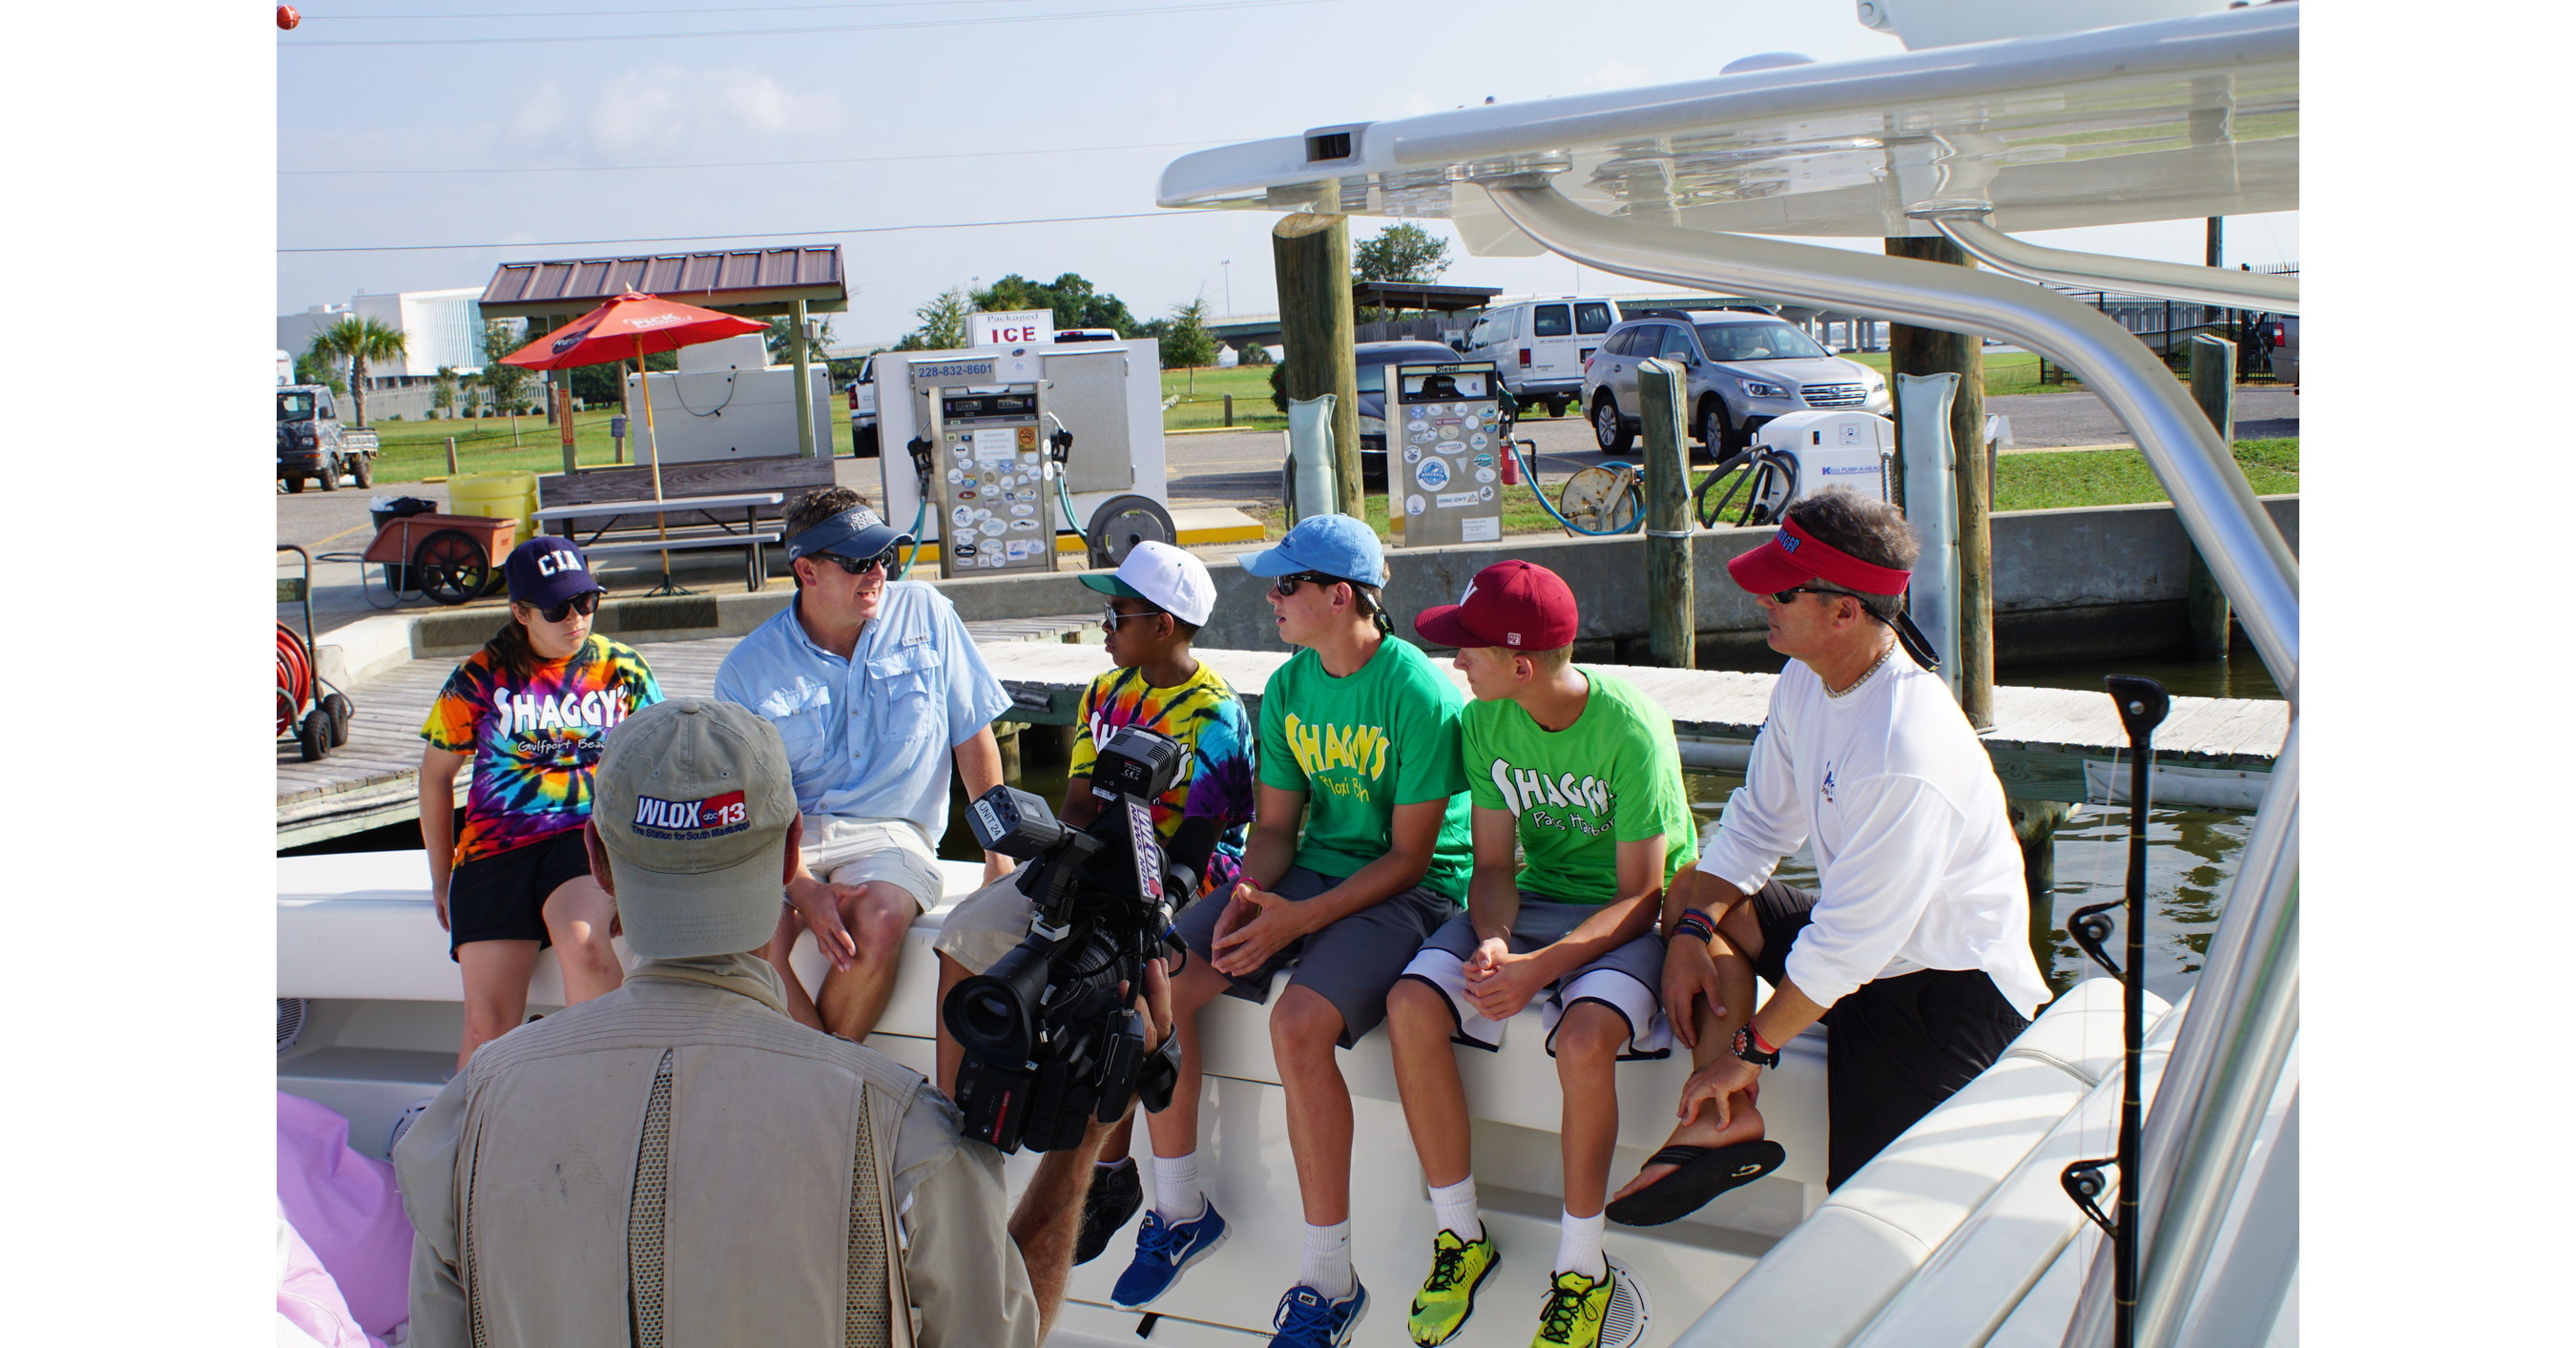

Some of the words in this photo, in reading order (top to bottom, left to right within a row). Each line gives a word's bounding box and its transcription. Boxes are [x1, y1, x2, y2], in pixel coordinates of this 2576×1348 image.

[987, 313, 1039, 323] Packaged
[991, 325, 1037, 344] ICE
[918, 363, 993, 378] 228-832-8601
[537, 550, 583, 577] CIA
[493, 684, 628, 741] SHAGGY'S
[517, 738, 572, 755] Gulfport
[577, 737, 607, 750] Beac
[635, 798, 703, 829] WLOX
[702, 810, 719, 820] abc
[717, 801, 746, 825] 13
[979, 801, 996, 828] UNIT
[989, 826, 1002, 838] 24
[632, 824, 645, 836] The
[646, 829, 673, 840] Station
[674, 830, 686, 840] for
[686, 829, 711, 840] South
[711, 819, 751, 838] Mississippi
[1130, 803, 1142, 851] NEWS
[1138, 857, 1152, 897] NOW
[1136, 808, 1162, 884] WLOX
